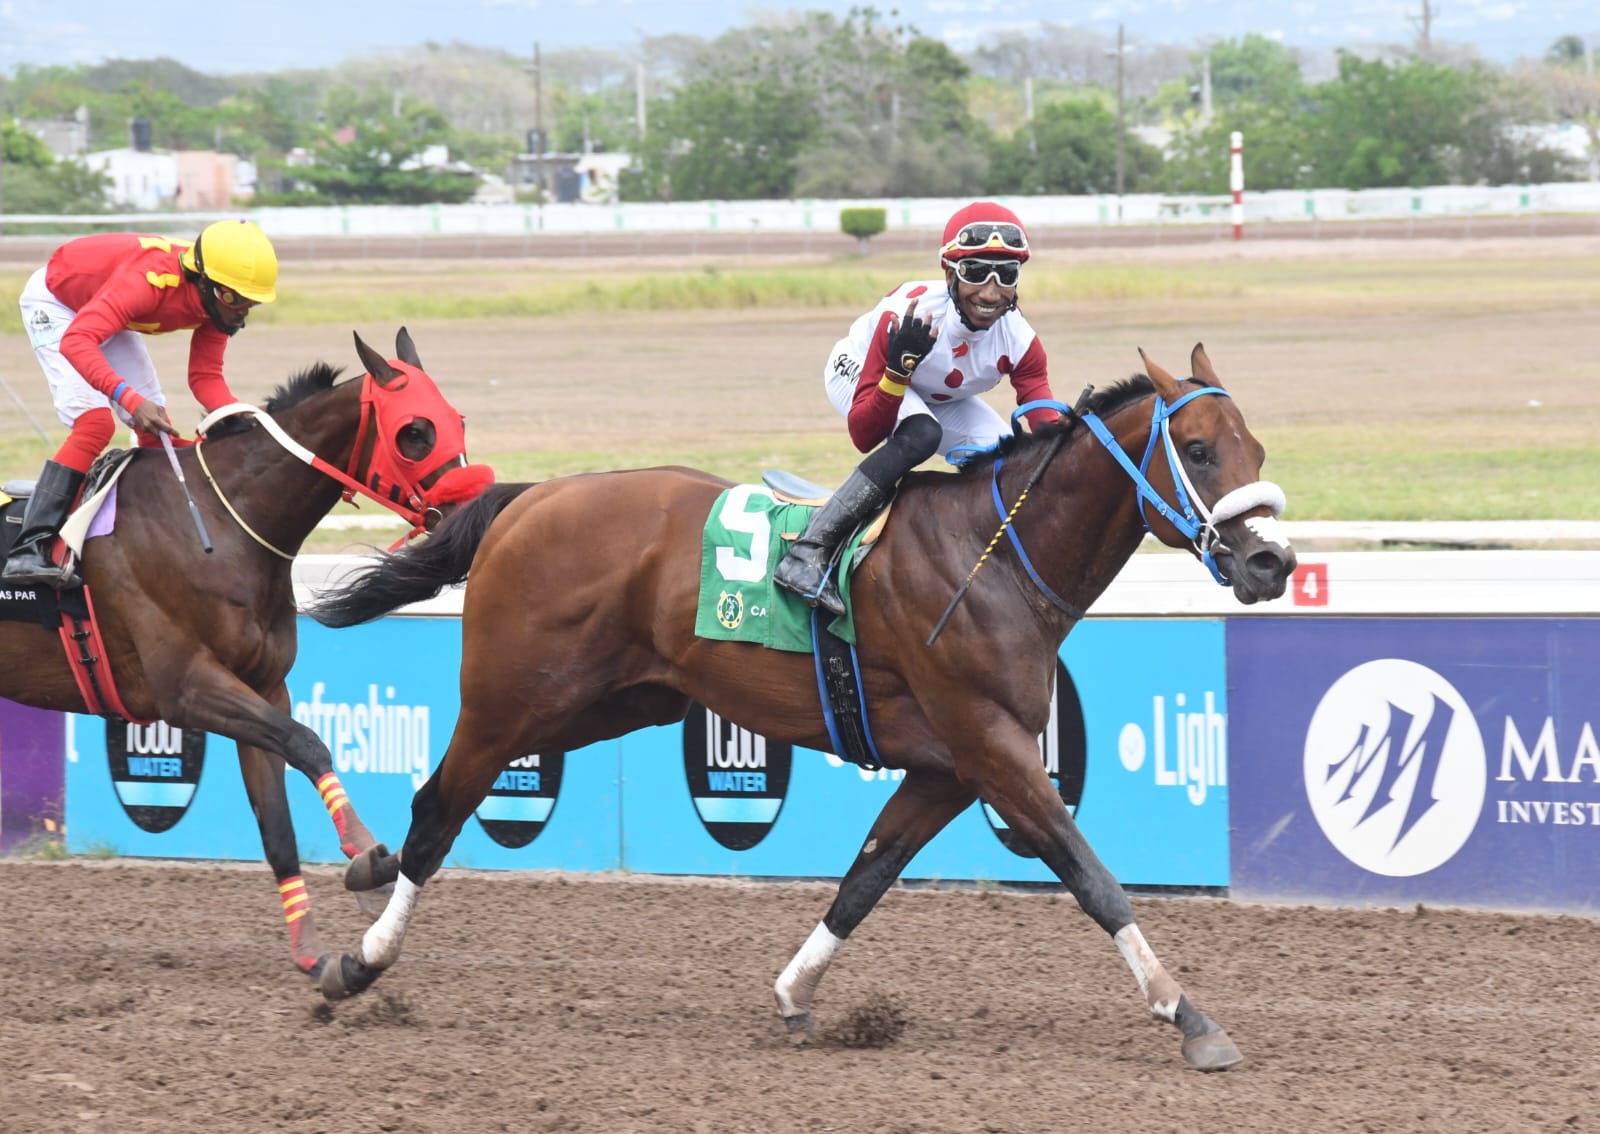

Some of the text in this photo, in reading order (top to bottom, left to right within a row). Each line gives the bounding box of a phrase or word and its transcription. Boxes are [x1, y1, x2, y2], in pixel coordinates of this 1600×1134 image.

[715, 484, 790, 583] 5
[1301, 571, 1319, 599] 4
[285, 681, 430, 792] freshing
[1153, 690, 1229, 806] Ligh
[127, 756, 182, 777] WATER
[491, 770, 540, 791] ATER
[707, 771, 767, 792] WATER
